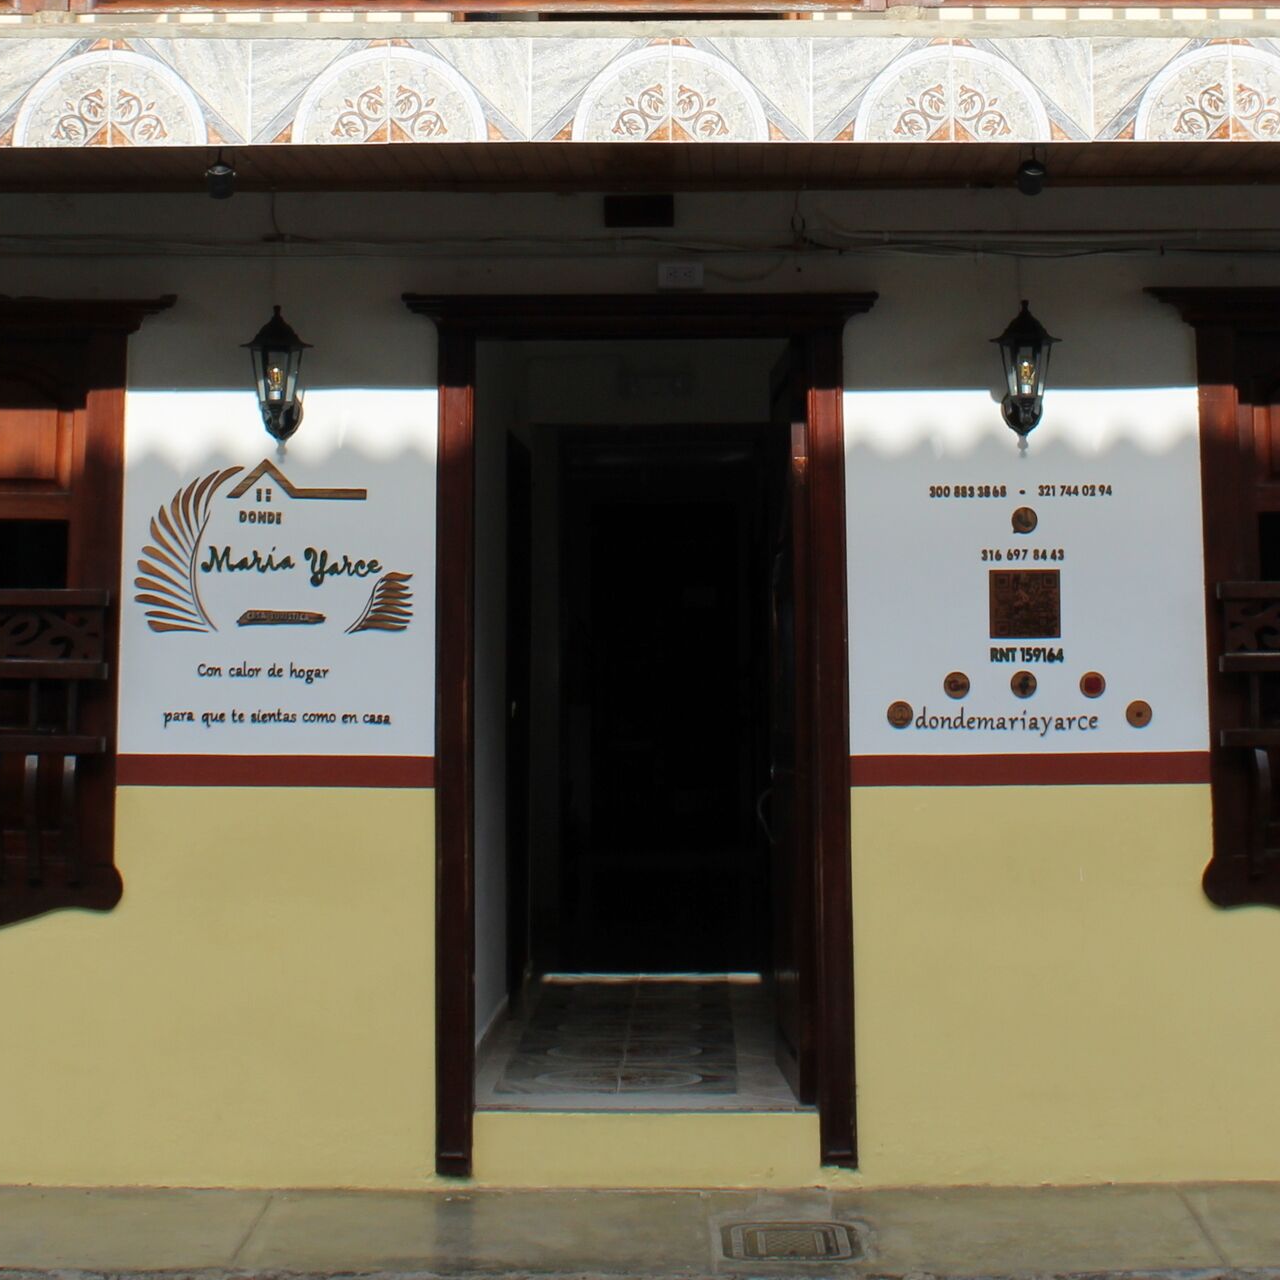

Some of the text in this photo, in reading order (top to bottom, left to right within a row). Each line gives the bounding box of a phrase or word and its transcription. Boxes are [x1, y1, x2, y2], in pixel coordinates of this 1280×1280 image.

[929, 485, 951, 499] 300
[1037, 484, 1056, 497] 321
[1059, 484, 1079, 497] 744
[238, 510, 282, 525] DONDE
[980, 548, 1003, 562] 316
[1006, 548, 1029, 562] 697
[200, 545, 383, 587] María Yarce
[989, 646, 1065, 664] RNT 159164
[196, 660, 330, 685] Con calor de hogar
[162, 708, 392, 729] para que te sientas como en casa
